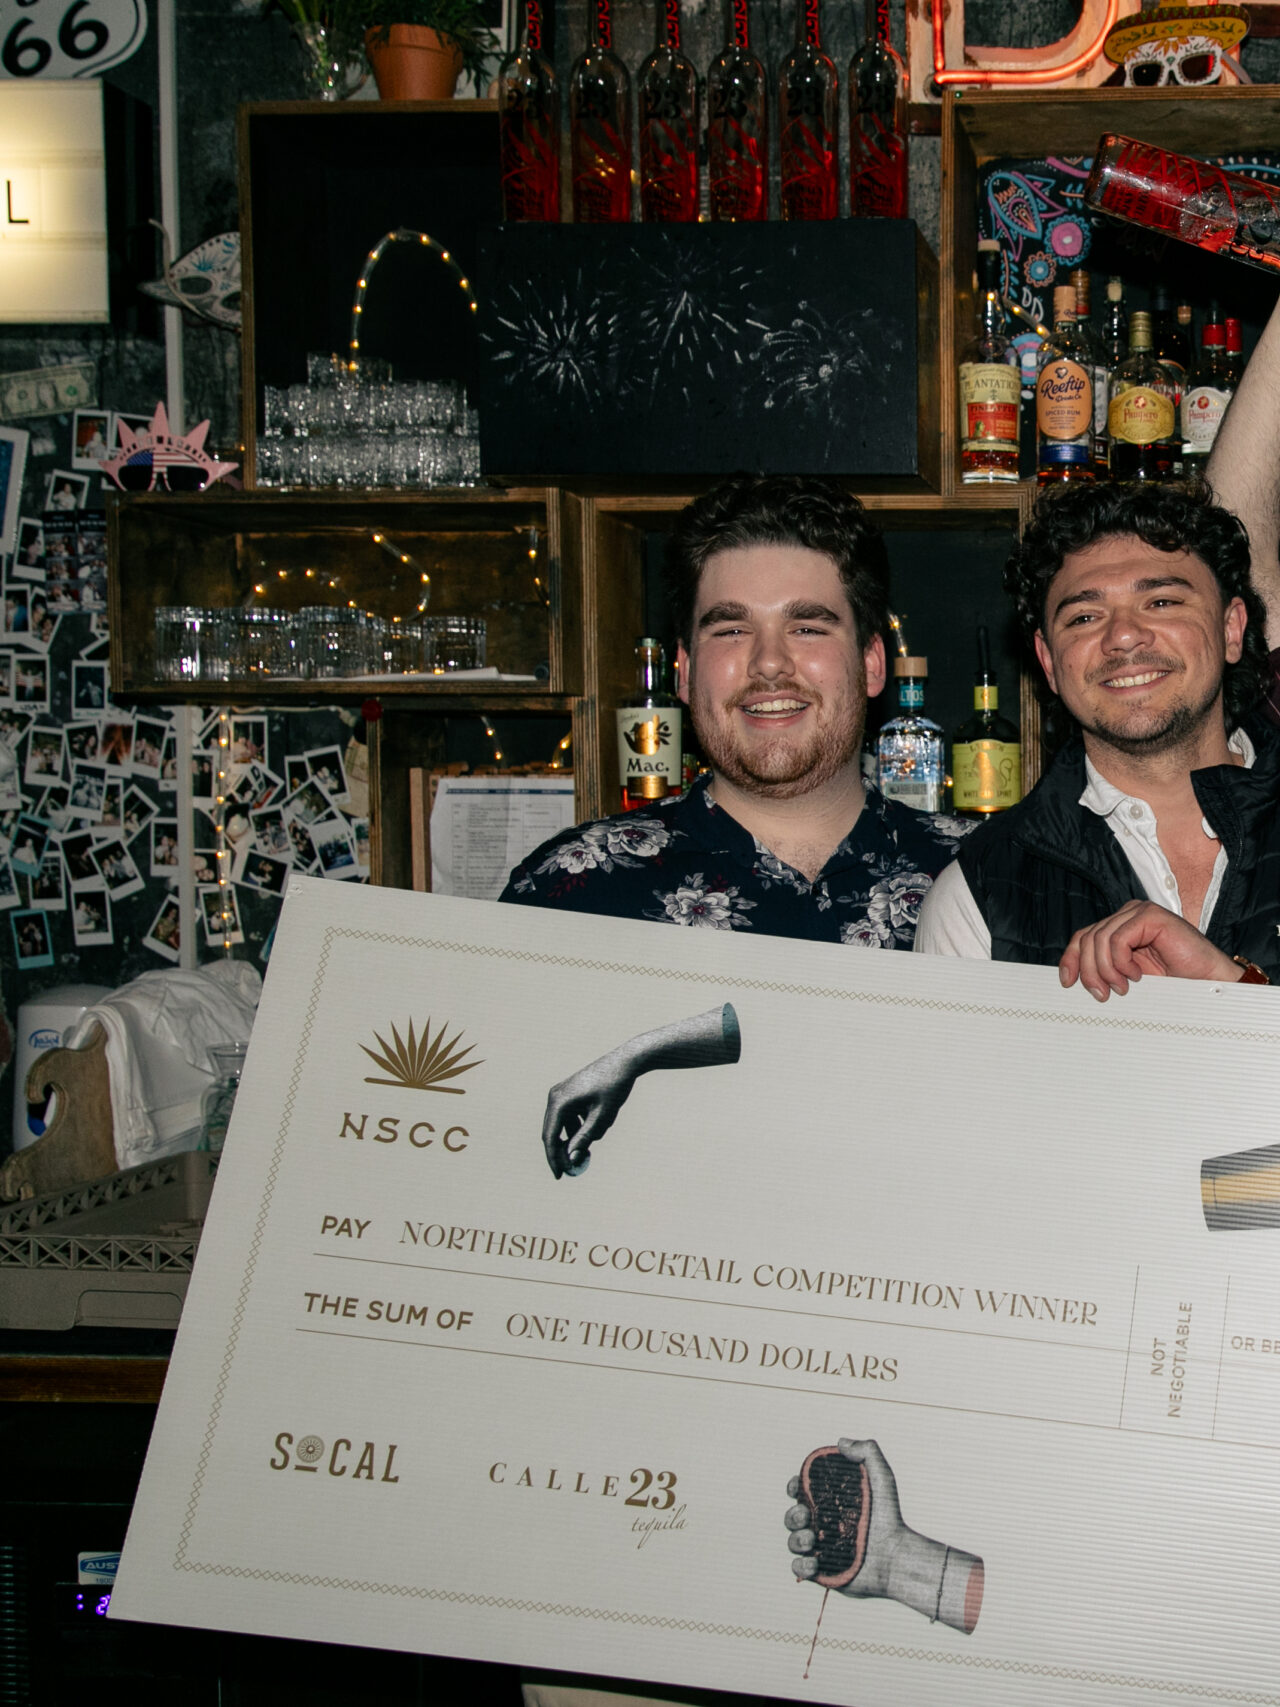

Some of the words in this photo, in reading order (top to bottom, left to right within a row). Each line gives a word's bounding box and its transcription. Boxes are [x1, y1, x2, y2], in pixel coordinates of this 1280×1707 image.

[2, 0, 109, 77] 66
[1041, 376, 1085, 401] Reeftip
[627, 758, 670, 772] Mac.
[339, 1112, 470, 1153] NSCC
[320, 1215, 372, 1240] PAY
[398, 1220, 579, 1265] NORTHSIDE
[587, 1243, 742, 1285] COCKTAIL
[752, 1264, 964, 1311] COMPETITION
[974, 1288, 1099, 1327] WINNER
[303, 1291, 359, 1319] THE
[365, 1299, 429, 1327] SUM
[436, 1308, 474, 1332] OF
[505, 1312, 570, 1344] ONE
[578, 1320, 750, 1365] THOUSAND
[758, 1342, 899, 1382] DOLLARS
[1150, 1337, 1167, 1377] NOT
[1167, 1301, 1193, 1419] NEGOTIABLE
[1230, 1335, 1256, 1352] OR
[488, 1461, 620, 1498] CALLE
[623, 1467, 678, 1511] 23
[630, 1503, 688, 1550] tequila
